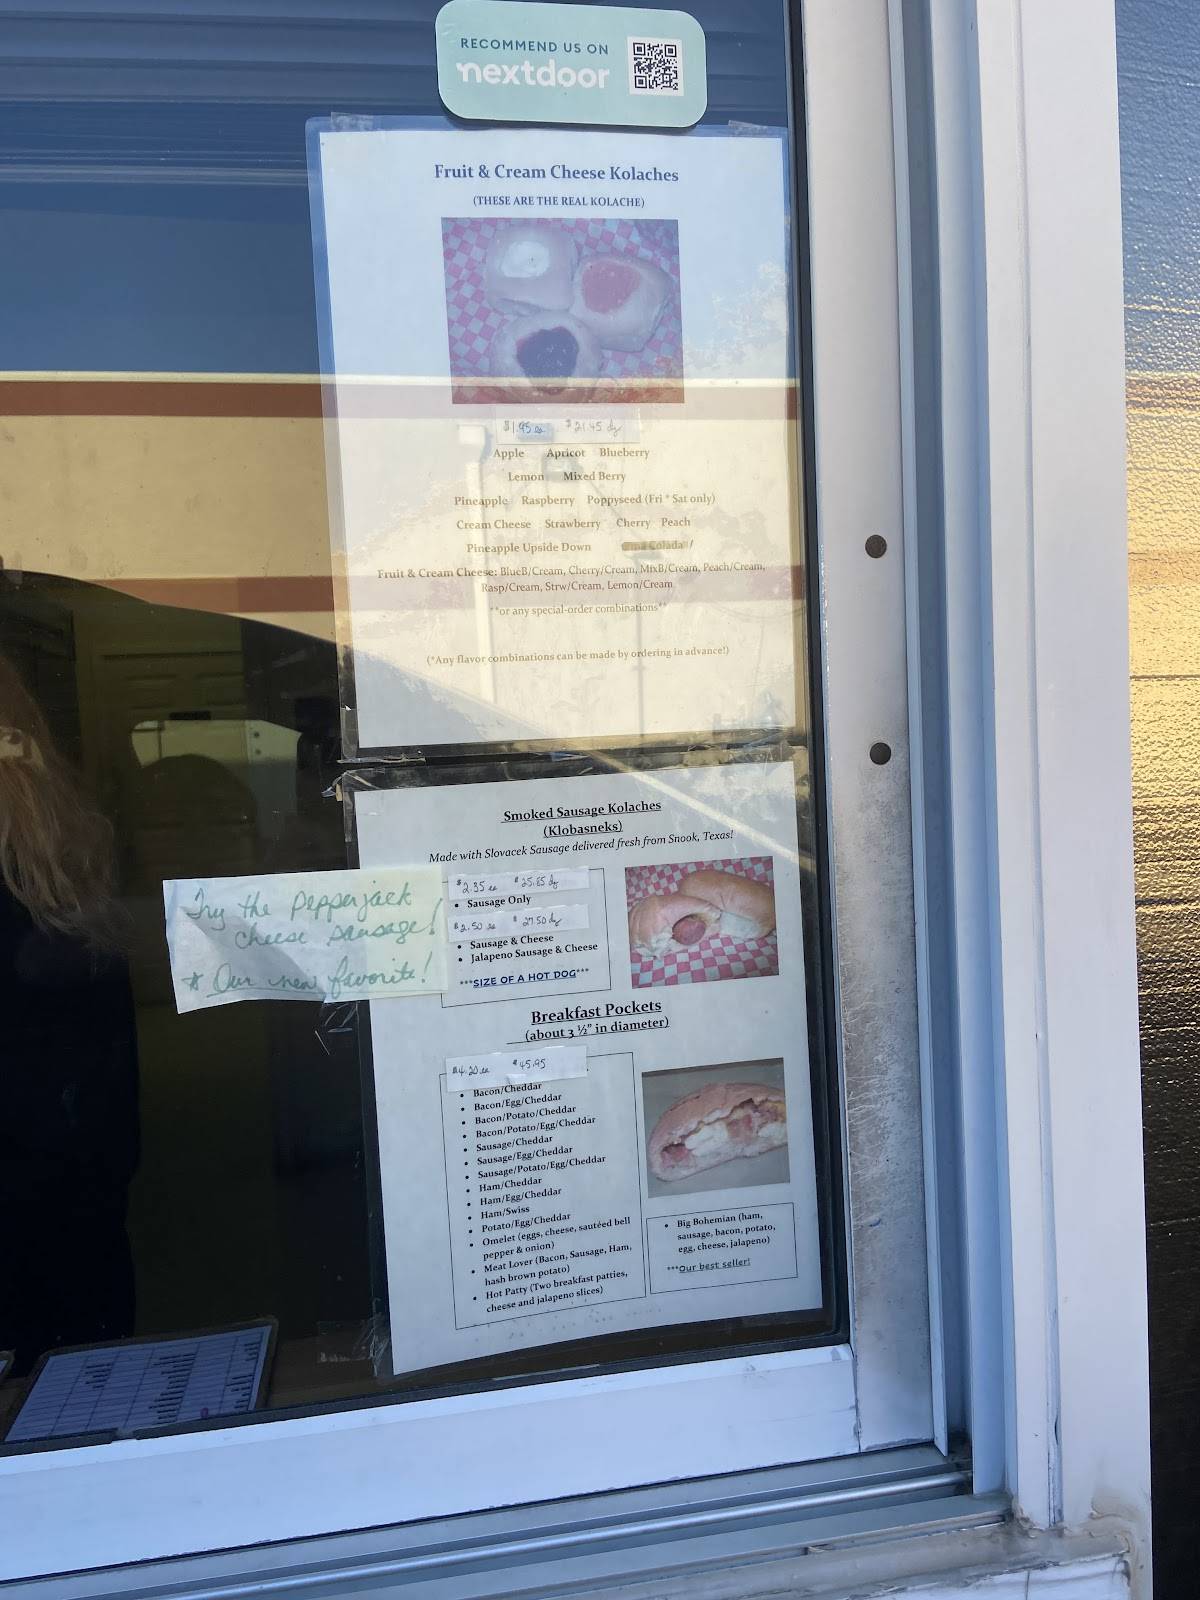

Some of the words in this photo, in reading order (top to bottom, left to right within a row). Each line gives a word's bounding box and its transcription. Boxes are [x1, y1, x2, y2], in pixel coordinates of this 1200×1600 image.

[461, 38, 558, 52] RECOMMEND
[563, 43, 581, 53] US
[587, 44, 609, 55] ON
[456, 59, 609, 89] nextdoor
[434, 164, 474, 178] Fruit
[478, 165, 490, 178] &
[494, 164, 546, 179] Cream
[551, 165, 606, 180] Cheese
[610, 166, 679, 182] Kolaches
[473, 196, 511, 206] (THESE
[513, 196, 534, 206] ARE
[537, 196, 559, 206] THE
[562, 197, 588, 207] REAL
[591, 197, 645, 208] KOLACHE)
[493, 449, 525, 460] Apple
[546, 450, 585, 459] Apricot
[600, 448, 650, 459] Blueberry
[508, 472, 545, 481] Lemon
[563, 472, 595, 481] Mixed
[599, 471, 626, 482] Berry
[454, 496, 508, 508] Pineapple
[521, 495, 575, 507] Raspberry
[587, 494, 642, 507] Poppyseed
[645, 494, 663, 504] (Fri
[672, 494, 688, 504] Sat
[690, 493, 716, 505] only)
[456, 520, 491, 530] Cream
[494, 519, 532, 529] Cheese
[545, 518, 601, 531] Strawberry
[616, 518, 651, 529] Cherry
[661, 517, 691, 527] Peach
[467, 543, 520, 555] Pineapple
[522, 543, 559, 555] Upside
[561, 542, 591, 552] Down
[378, 570, 404, 579] Fruit
[407, 570, 415, 578] &
[419, 569, 454, 578] Cream
[456, 568, 498, 577] Cheese:
[500, 566, 566, 577] BlueB/Cream,
[568, 565, 638, 576] Cherry/Cream,
[640, 563, 701, 574] MixB/Cream,
[703, 562, 766, 572] Peach/Cream,
[481, 582, 543, 593] Rasp/Cream,
[545, 580, 605, 593] Strw/Cream,
[607, 580, 673, 590] Lemon/Cream
[512, 606, 530, 617] any
[531, 604, 593, 616] special-order
[457, 654, 485, 664] flavor
[488, 652, 555, 663] combinations
[556, 652, 574, 660] can
[576, 651, 587, 660] be
[590, 650, 616, 659] made
[618, 649, 629, 660] by
[631, 648, 671, 659] ordering
[674, 648, 683, 656] in
[685, 646, 730, 655] advance!)
[504, 807, 554, 821] Smoked
[557, 806, 605, 818] Sausage
[608, 801, 662, 814] Kolaches
[543, 820, 623, 838] (Klobasneks)
[429, 852, 458, 863] Made
[460, 849, 482, 860] with
[485, 846, 528, 859] Slovacek
[530, 842, 570, 855] Sausage
[572, 838, 615, 851] delivered
[616, 836, 641, 851] fresh
[641, 836, 666, 849] from
[668, 832, 700, 844] Snook,
[703, 830, 734, 841] Texas!
[187, 887, 226, 931] Try
[237, 891, 271, 920] the
[467, 898, 506, 908] Sausage
[508, 895, 532, 905] Only
[234, 923, 307, 950] cheese
[470, 937, 508, 950] Sausage
[510, 937, 518, 945] &
[520, 935, 554, 944] Cheese
[471, 951, 513, 964] Jalapeno
[515, 948, 553, 958] Sausage
[555, 945, 562, 953] &
[565, 943, 598, 953] Cheese
[213, 963, 257, 992] Our
[268, 975, 318, 991] new
[500, 975, 514, 984] OF
[528, 972, 550, 981] HOT
[531, 1006, 601, 1025] Breakfast
[605, 1000, 662, 1016] Pockets
[525, 1027, 565, 1042] (about
[568, 1028, 575, 1039] 3
[595, 1023, 607, 1034] in
[610, 1016, 670, 1033] diameter)
[473, 1083, 543, 1097] Bacon/Cheddar
[474, 1093, 562, 1112] Bacon/Egg/Cheddar
[475, 1105, 577, 1125] Bacon/Potato/Cheddar
[475, 1116, 597, 1139] Bacon/Potato/Egg/Cheddar
[476, 1135, 554, 1153] Sausage/Cheddar
[477, 1146, 573, 1166] Sausage/Egg/Cheddar
[477, 1155, 606, 1179] Sausage/Potato/Egg/Cheddar
[479, 1177, 543, 1193] Ham/Cheddar
[480, 1187, 562, 1206] Ham/Egg/Cheddar
[480, 1206, 530, 1220] Ham/Swiss
[677, 1220, 691, 1229] Big
[693, 1215, 737, 1226] Bohemian
[738, 1212, 763, 1223] (ham,
[481, 1213, 571, 1233] Potato/Egg/Cheddar
[482, 1235, 516, 1246] Omelet
[517, 1230, 543, 1241] (eggs,
[545, 1227, 577, 1236] cheese,
[614, 1217, 631, 1226] bell
[677, 1231, 713, 1241] sausage,
[715, 1228, 744, 1237] bacon,
[745, 1223, 776, 1235] potato,
[483, 1249, 514, 1261] pepper
[525, 1241, 555, 1252] onion)
[678, 1244, 696, 1255] egg,
[697, 1240, 729, 1251] cheese,
[730, 1236, 771, 1249] jalapeno)
[484, 1264, 507, 1273] Meat
[509, 1259, 533, 1269] Lover
[535, 1254, 568, 1265] (Bacon,
[569, 1249, 607, 1259] Sausage,
[608, 1244, 632, 1252] Ham,
[699, 1261, 720, 1271] best
[722, 1257, 751, 1269] seller!
[485, 1275, 506, 1286] hash
[508, 1271, 536, 1282] brown
[538, 1265, 570, 1278] potato)
[486, 1290, 503, 1300] Hot
[505, 1286, 528, 1297] Patty
[530, 1283, 552, 1293] (Two
[553, 1275, 594, 1288] breakfast
[596, 1270, 628, 1282] patties,
[486, 1301, 516, 1313] cheese
[518, 1297, 535, 1307] and
[537, 1292, 575, 1304] jalapeno
[576, 1285, 603, 1297] slices)
